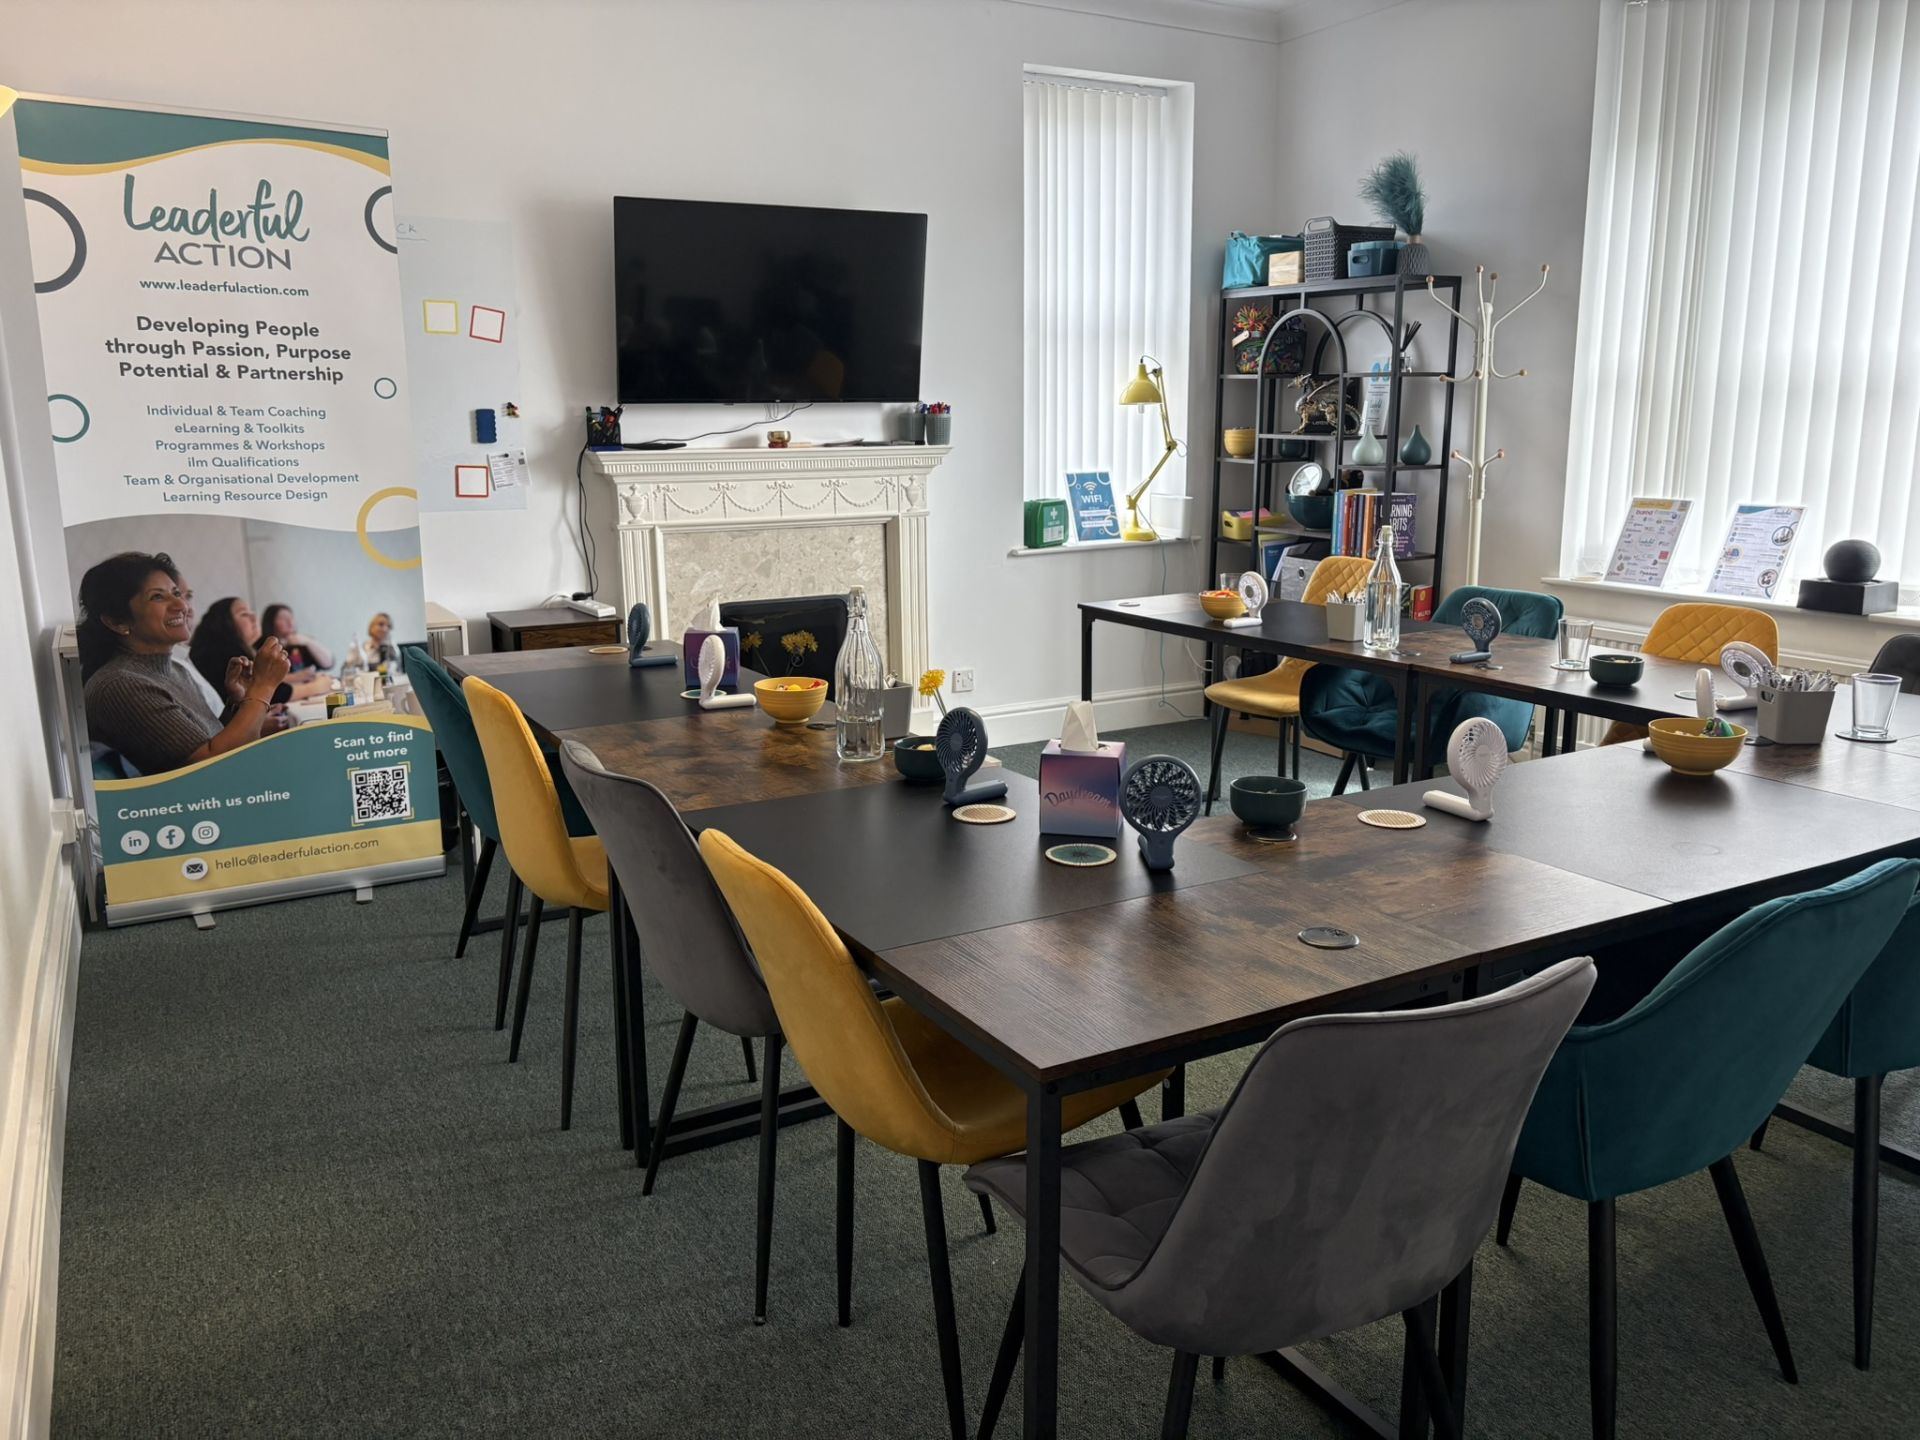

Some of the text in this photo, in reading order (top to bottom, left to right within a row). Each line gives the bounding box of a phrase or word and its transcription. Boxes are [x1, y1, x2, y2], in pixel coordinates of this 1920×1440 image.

[123, 173, 310, 243] Leaderful
[154, 241, 291, 270] ACTION
[139, 279, 309, 296] www.leaderfulaction.com
[136, 315, 319, 340] Developing People
[105, 338, 351, 363] through Passion, Purpose
[119, 362, 343, 385] Potential & Partnership
[146, 405, 326, 419] Individual & Team Coaching
[174, 423, 305, 435] eLearning & Toolkits
[155, 440, 325, 453] Programmes & Workshops
[187, 457, 299, 468] ilm Qualifications
[123, 473, 359, 487] Team & Organisational Development
[163, 489, 328, 504] Learning Resource Design
[334, 729, 413, 749] Scan to find
[346, 747, 408, 761] out more
[117, 790, 291, 820] Connect with us online
[1043, 787, 1112, 809] Daydream
[128, 837, 142, 847] in
[215, 839, 379, 870] hello@leaderfulaction.com
